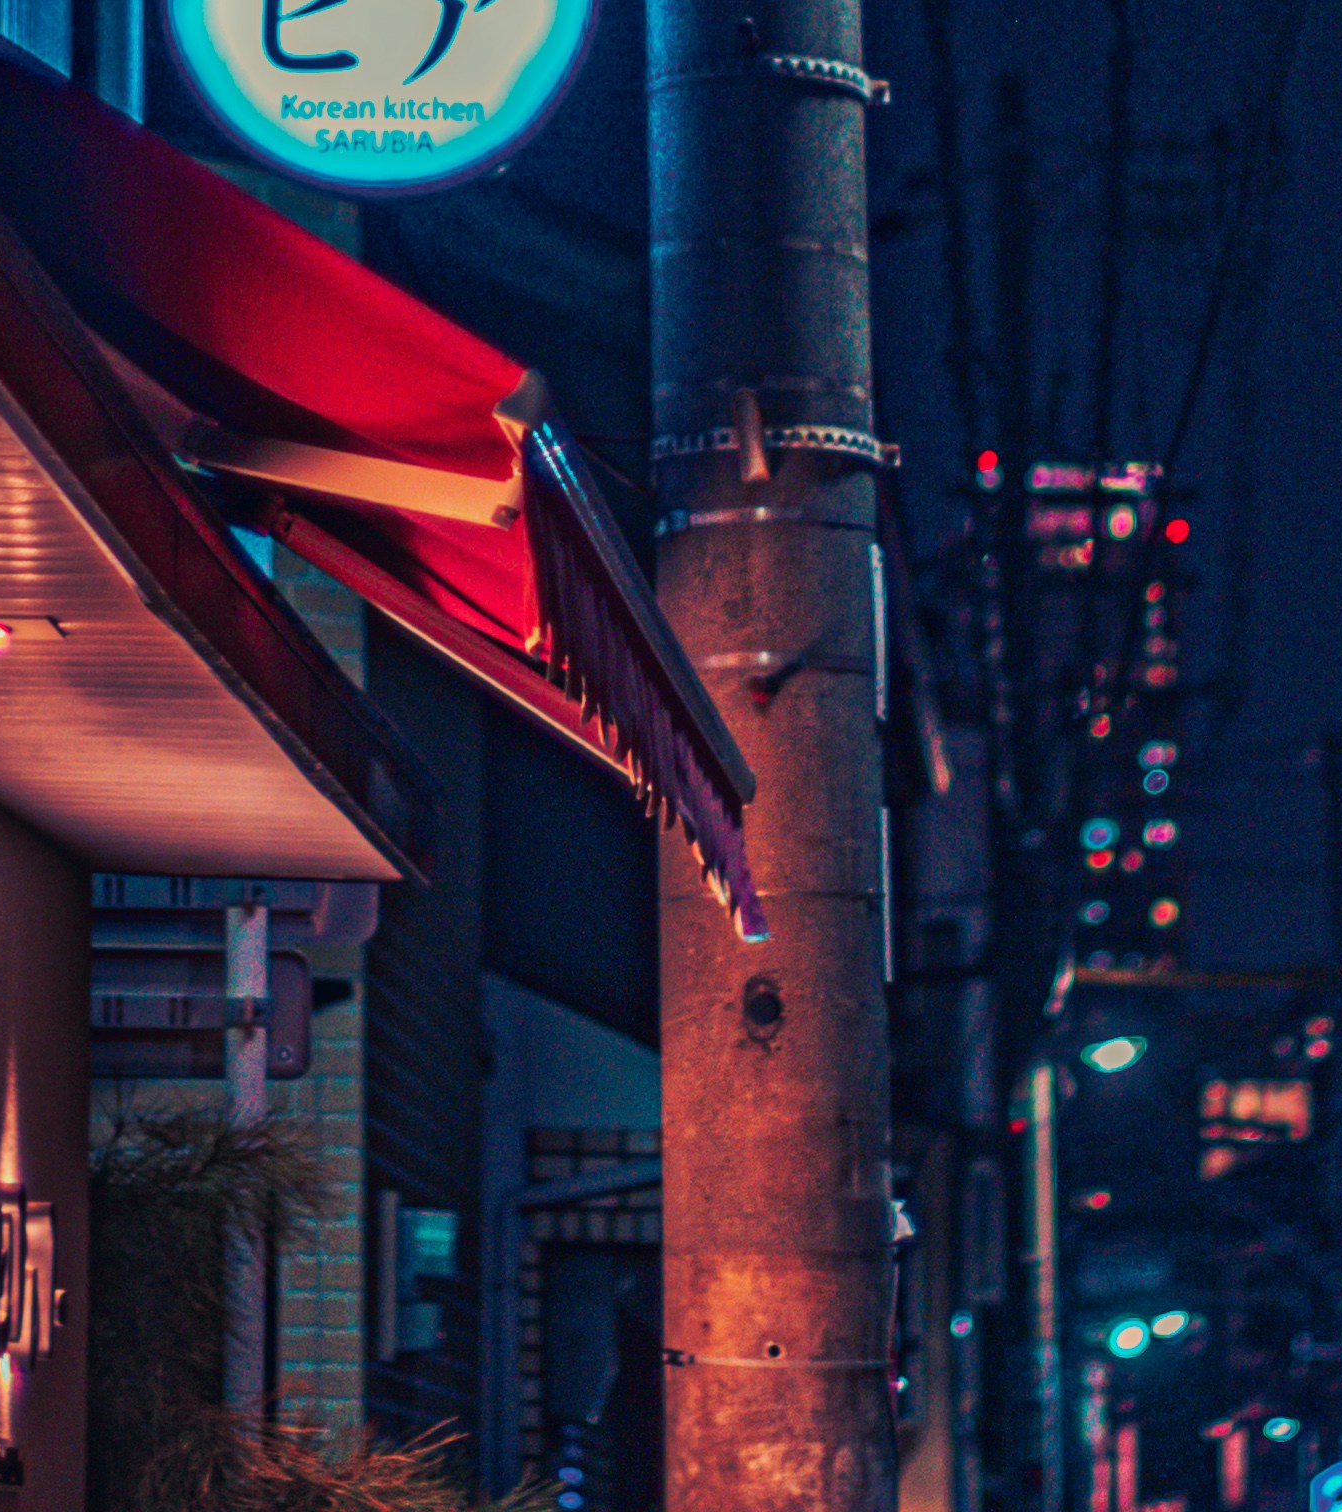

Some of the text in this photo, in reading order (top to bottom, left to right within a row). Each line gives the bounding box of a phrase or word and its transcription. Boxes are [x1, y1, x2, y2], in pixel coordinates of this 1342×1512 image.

[280, 94, 486, 123] Korean kitchen
[315, 128, 434, 154] SARUBIA
